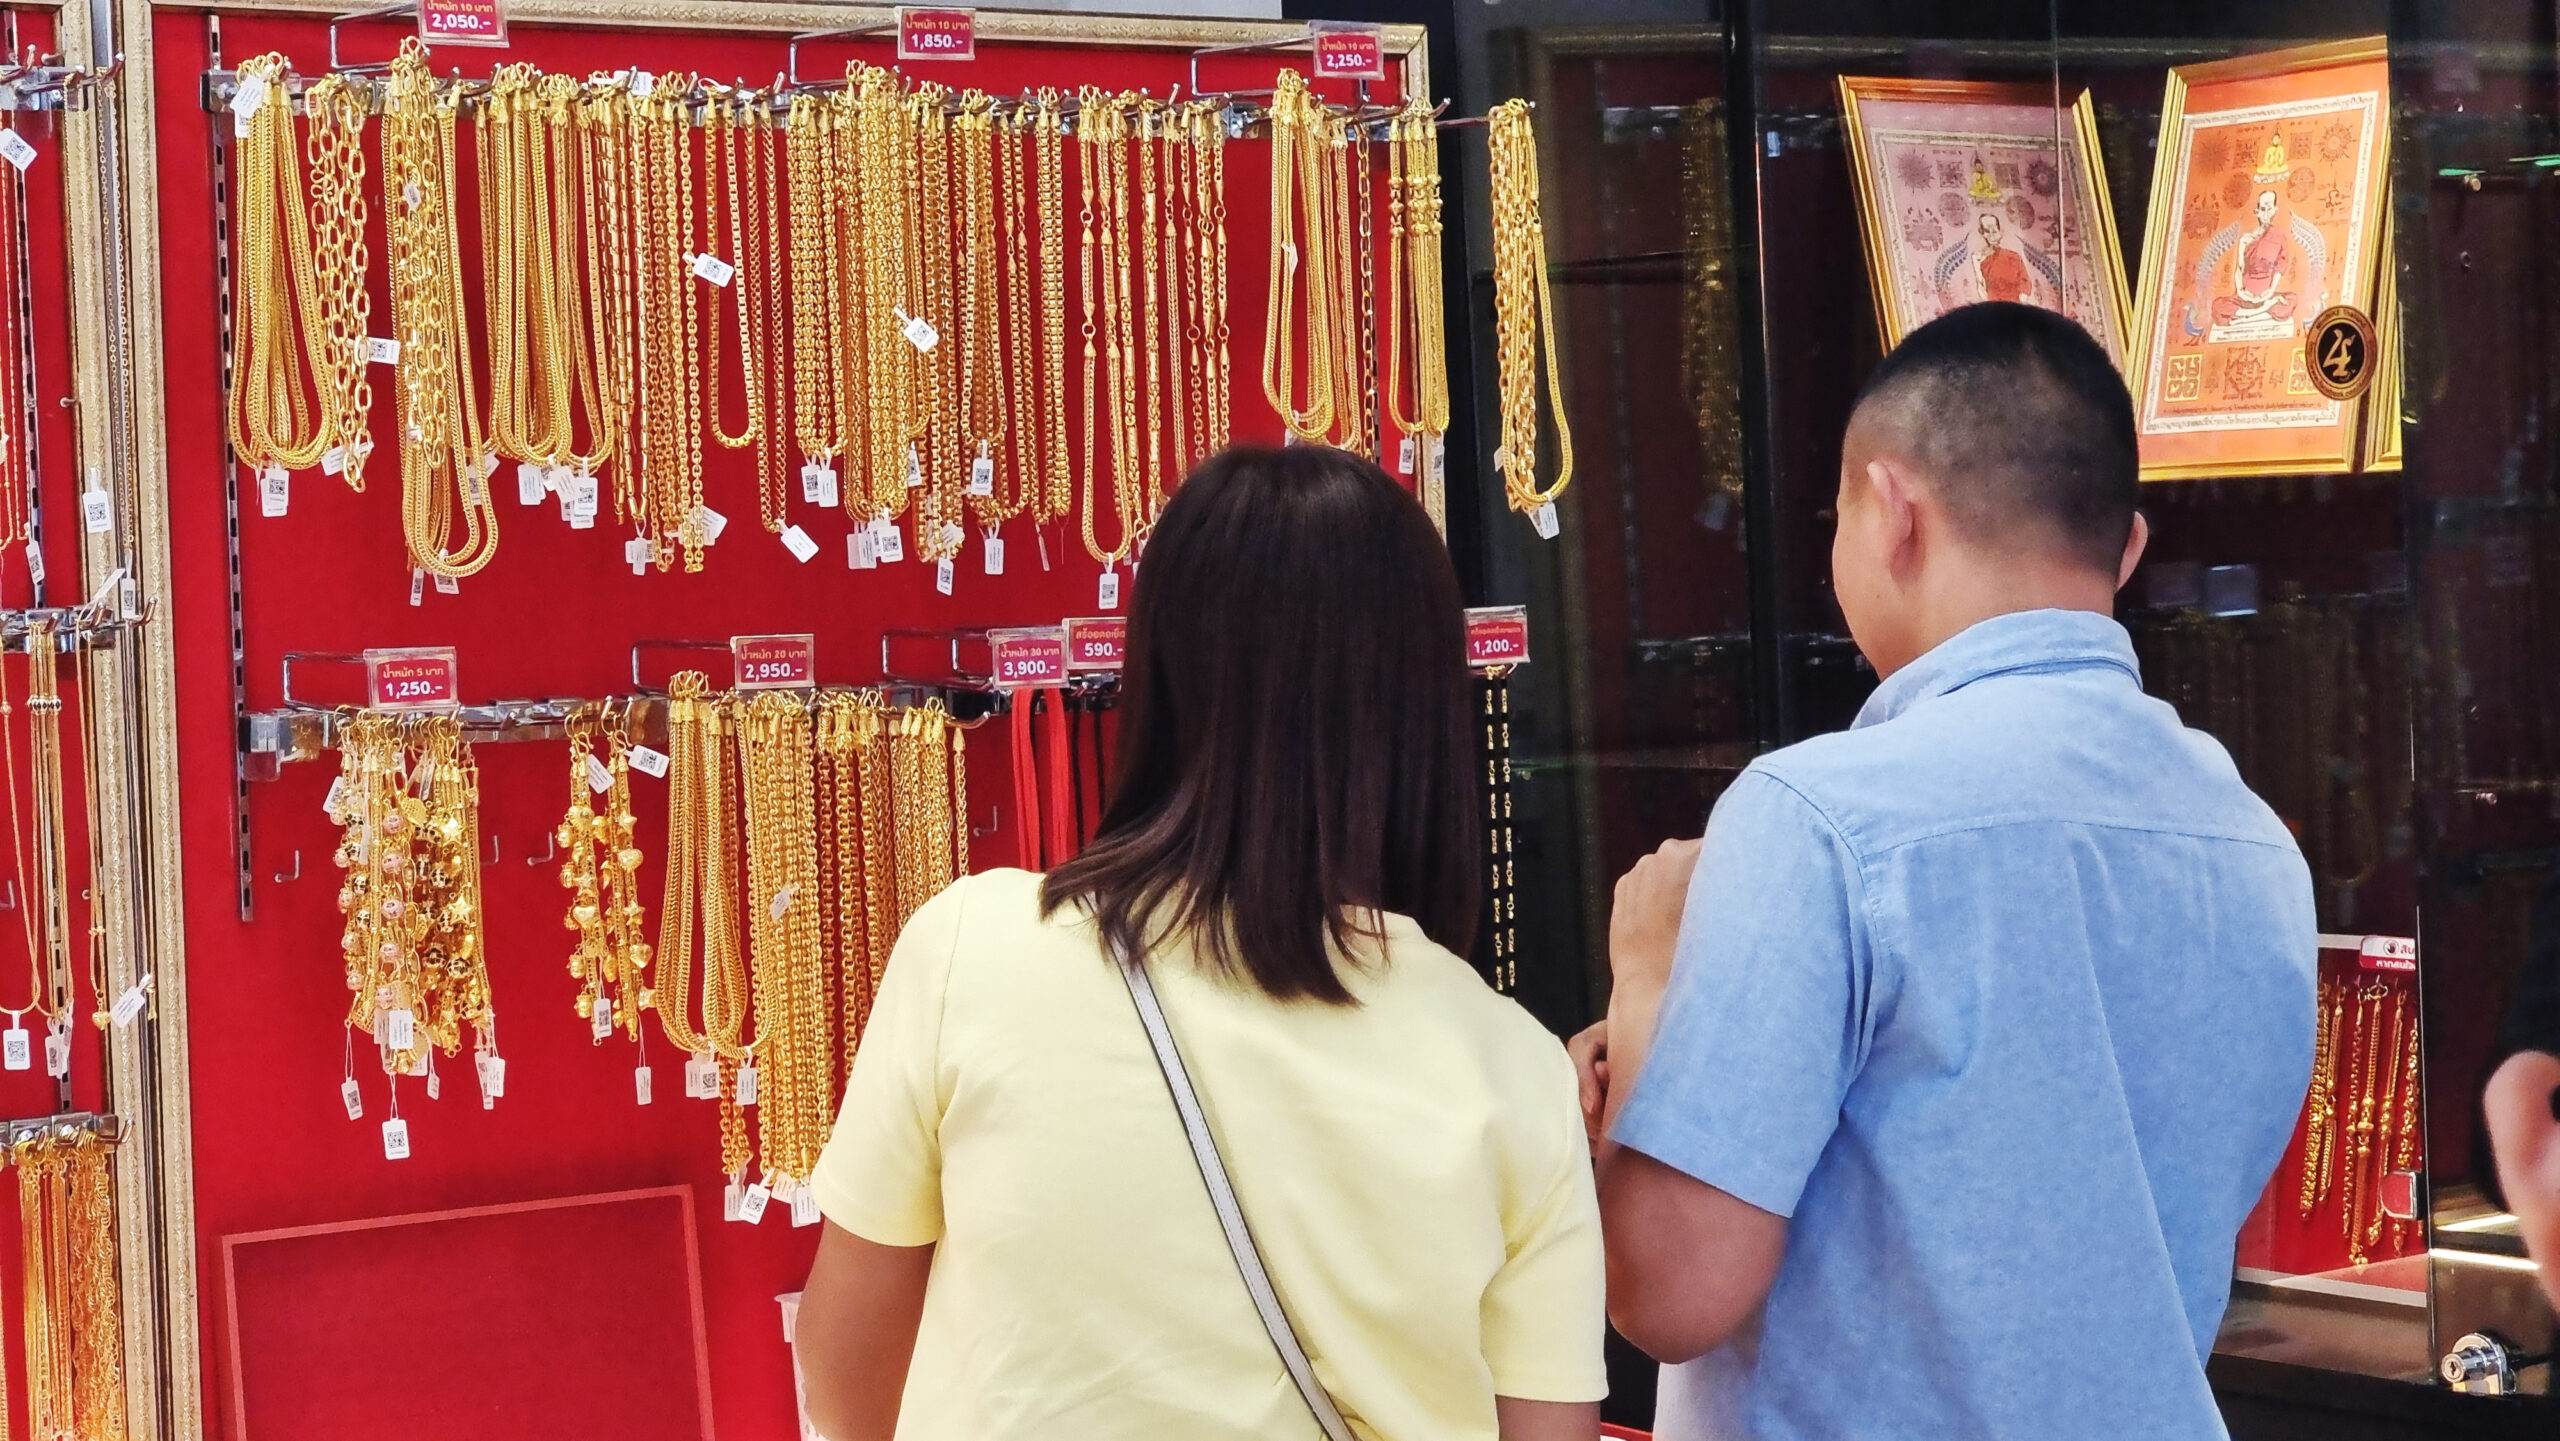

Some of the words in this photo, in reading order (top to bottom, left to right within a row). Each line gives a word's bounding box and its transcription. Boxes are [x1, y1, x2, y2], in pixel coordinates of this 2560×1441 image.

[461, 3, 473, 12] 10
[474, 4, 494, 12] บาท
[431, 13, 492, 31] 2,050.-
[938, 21, 950, 30] 10
[952, 21, 970, 31] บาท
[911, 33, 964, 51] 1,850.-
[1348, 43, 1358, 51] 10
[1359, 43, 1375, 51] บาท
[1326, 53, 1372, 70] 2,250.-
[741, 645, 772, 660] น้ำหนัก
[774, 649, 786, 659] 20
[788, 649, 807, 659] บาท
[1030, 648, 1042, 657] 30
[1043, 647, 1060, 656] บาท
[1084, 642, 1124, 657] 590.-
[1473, 639, 1519, 657] 1,200.-
[383, 664, 414, 679] น้ำหนัก
[416, 667, 423, 676] 5
[425, 667, 444, 676] บาท
[745, 662, 803, 682] 2,950.-
[1003, 660, 1057, 679] 3,900.-
[385, 680, 443, 700] 1,250.-
